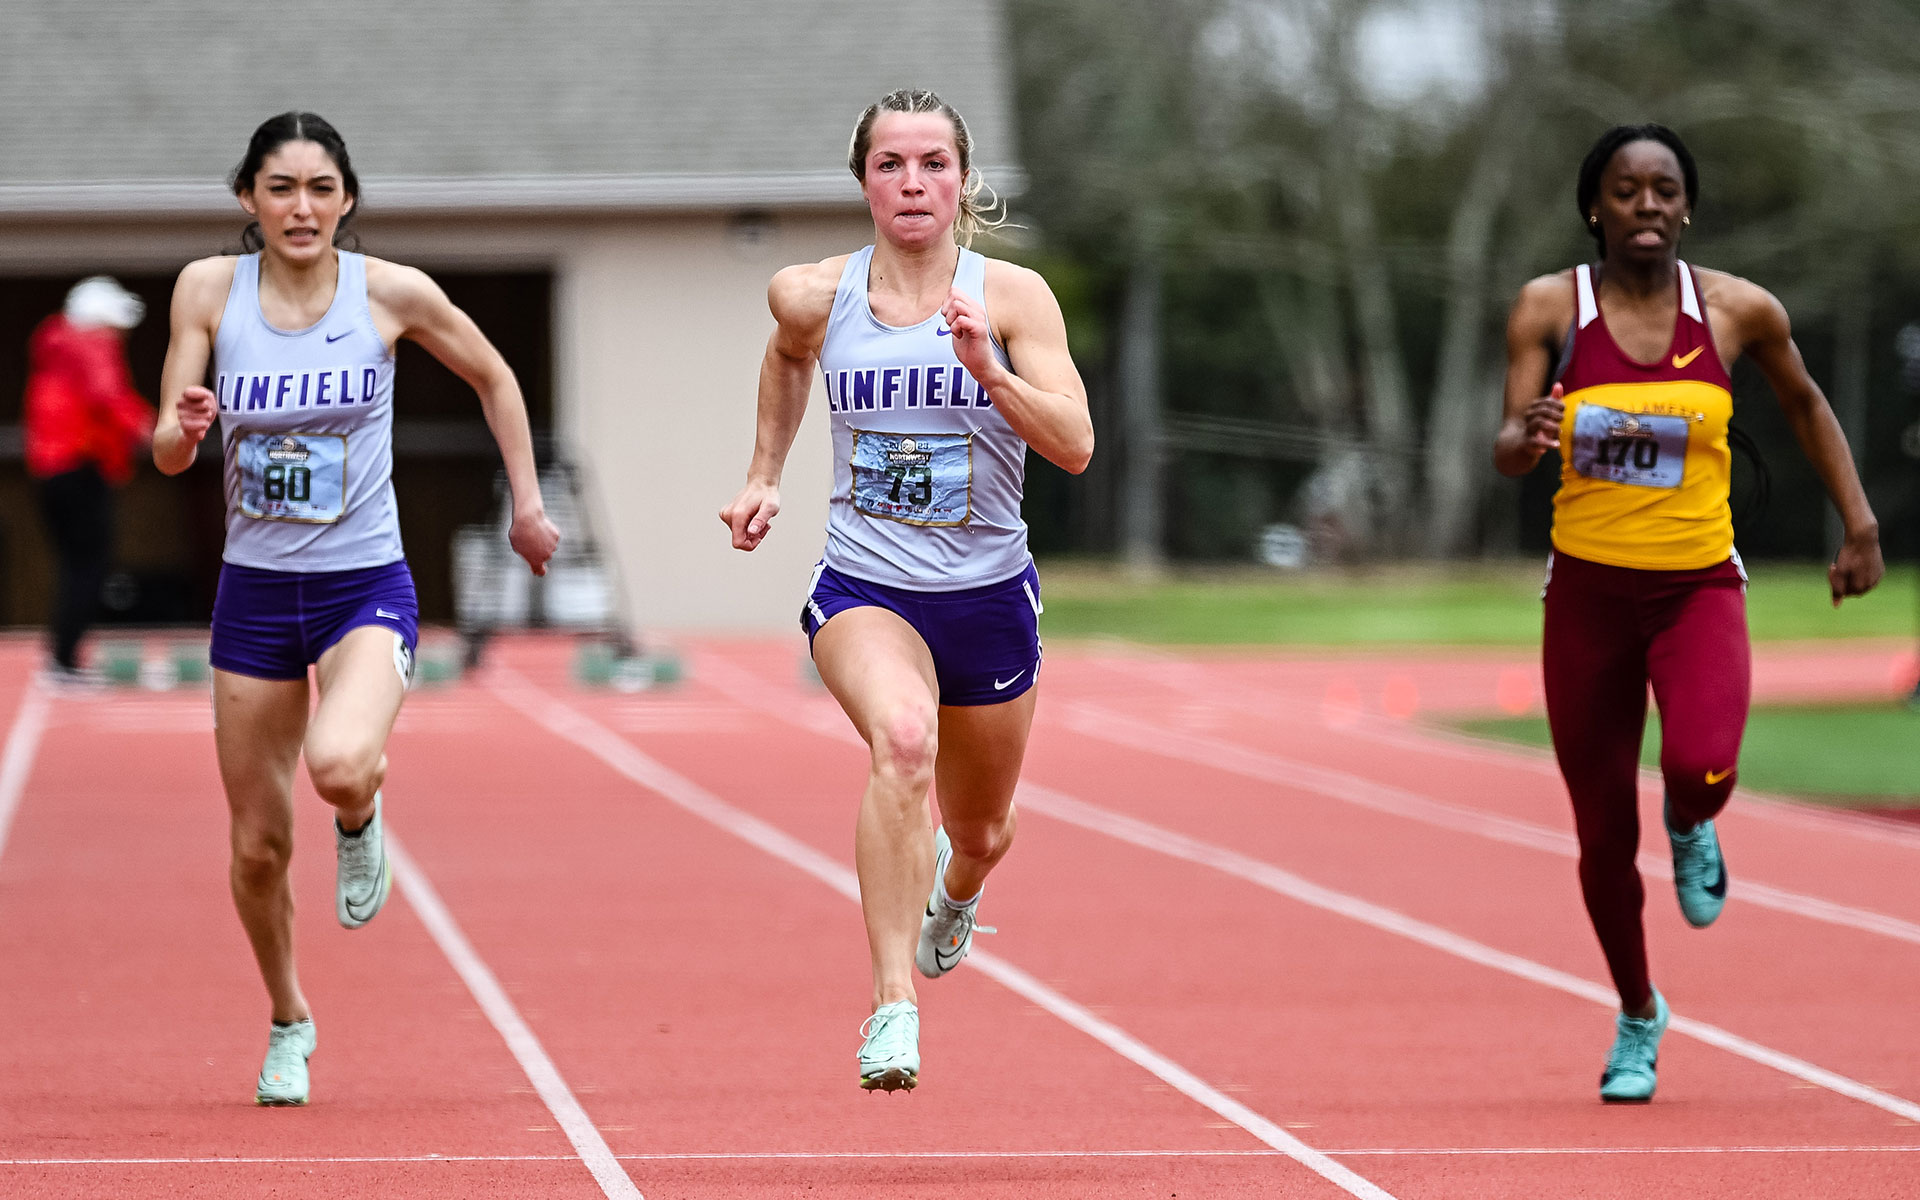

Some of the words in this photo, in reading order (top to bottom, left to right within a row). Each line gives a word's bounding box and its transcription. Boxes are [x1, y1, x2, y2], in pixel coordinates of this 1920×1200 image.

[217, 366, 378, 413] LINFIELD
[889, 452, 930, 461] NORTHWEST
[1597, 438, 1659, 469] 170
[264, 465, 311, 501] 80
[884, 465, 932, 505] 73
